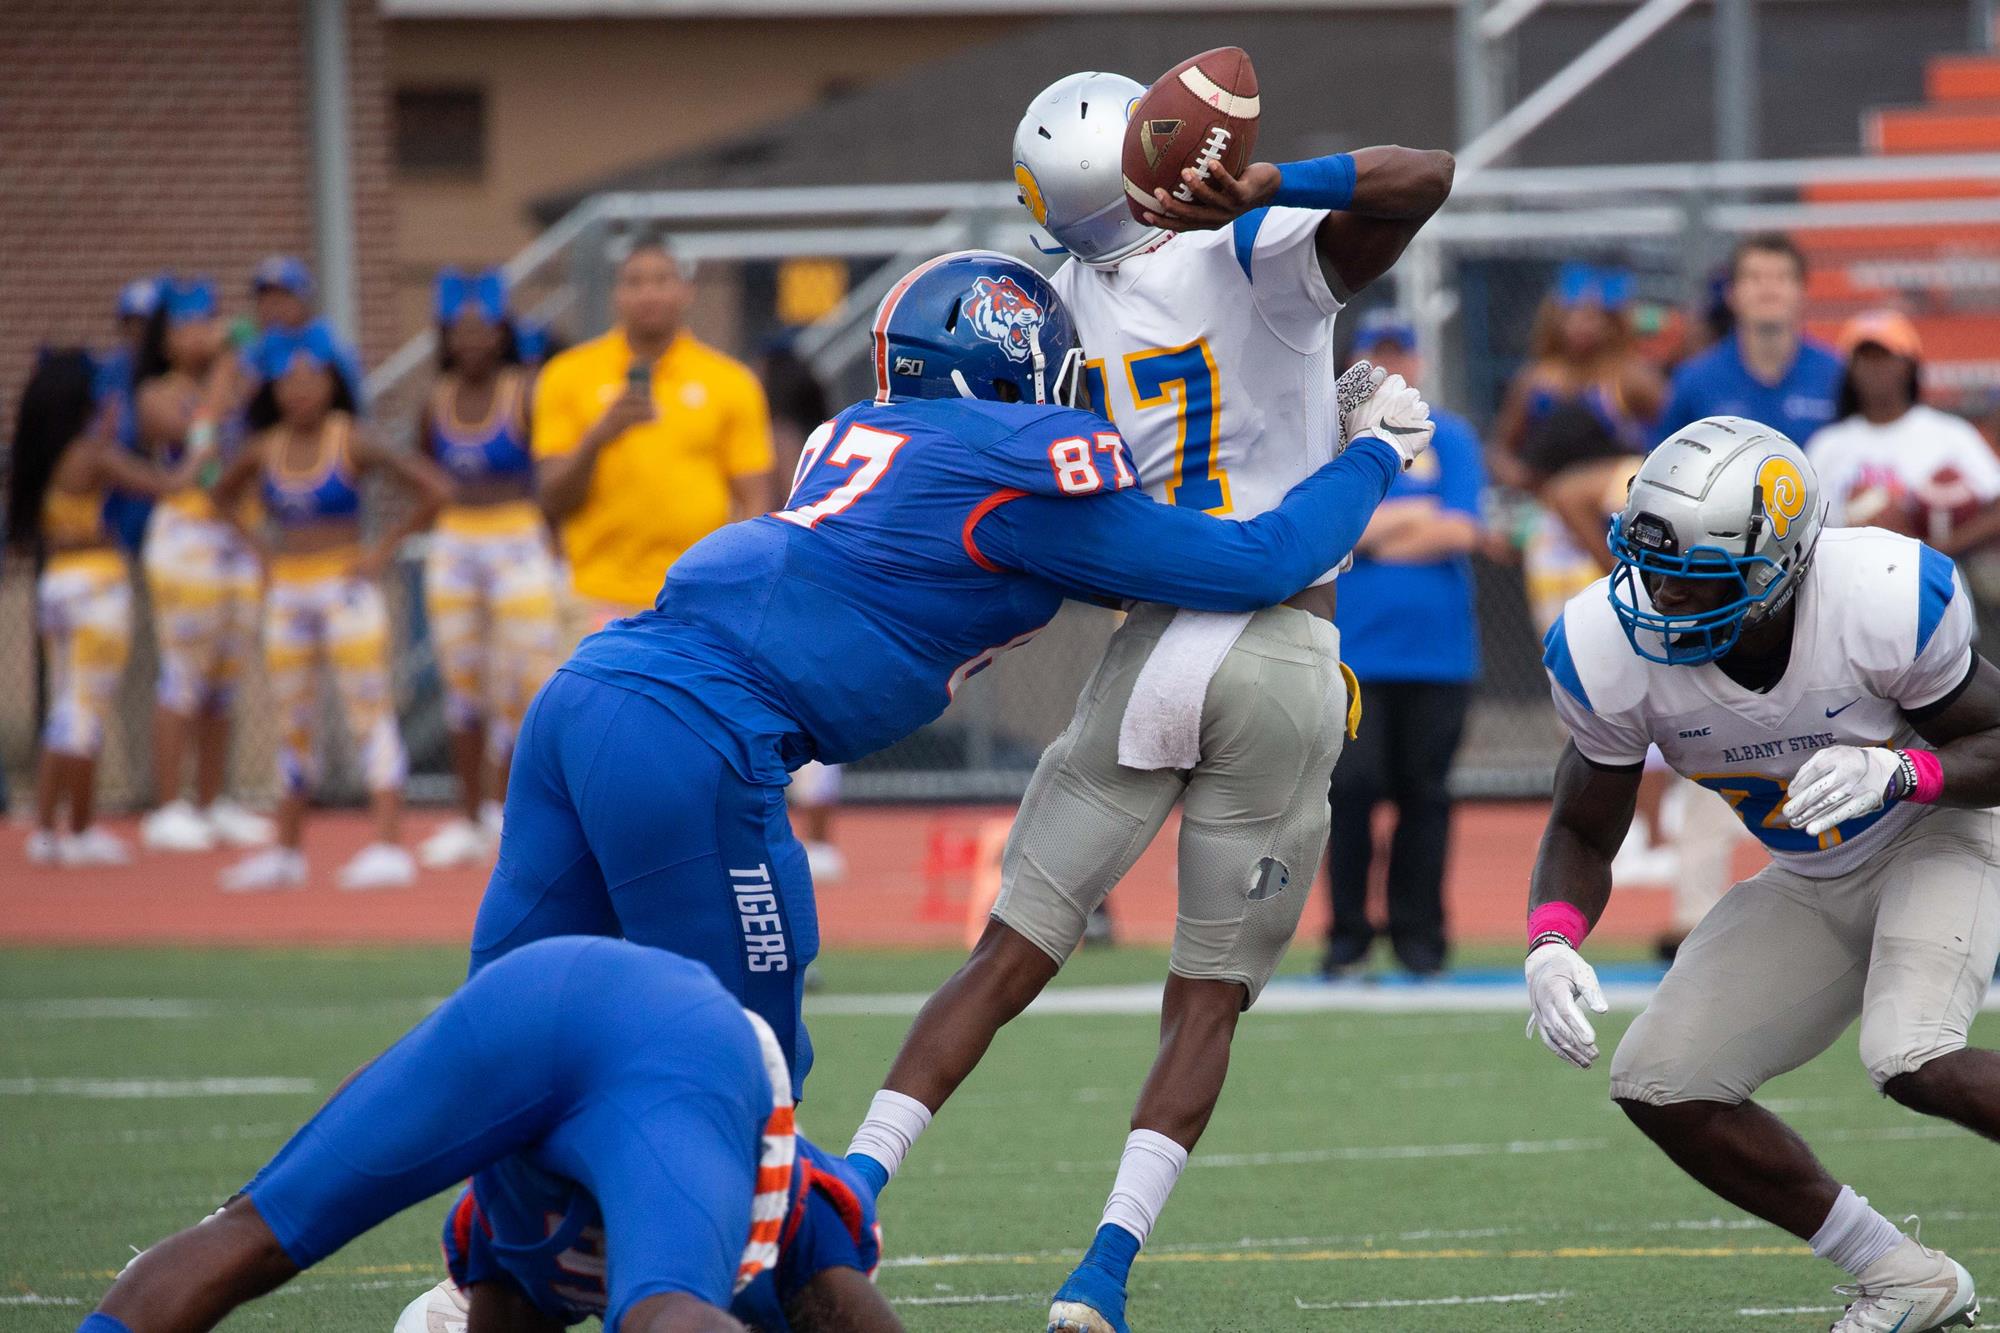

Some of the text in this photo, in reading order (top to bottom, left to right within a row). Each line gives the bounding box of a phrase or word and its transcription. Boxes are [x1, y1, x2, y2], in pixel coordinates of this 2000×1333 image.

[1048, 431, 1136, 496] 87
[1678, 727, 1712, 739] SIAC
[1722, 732, 1837, 763] ALBANY STATE
[1904, 760, 1917, 785] LEAVE
[729, 863, 788, 972] TIGERS
